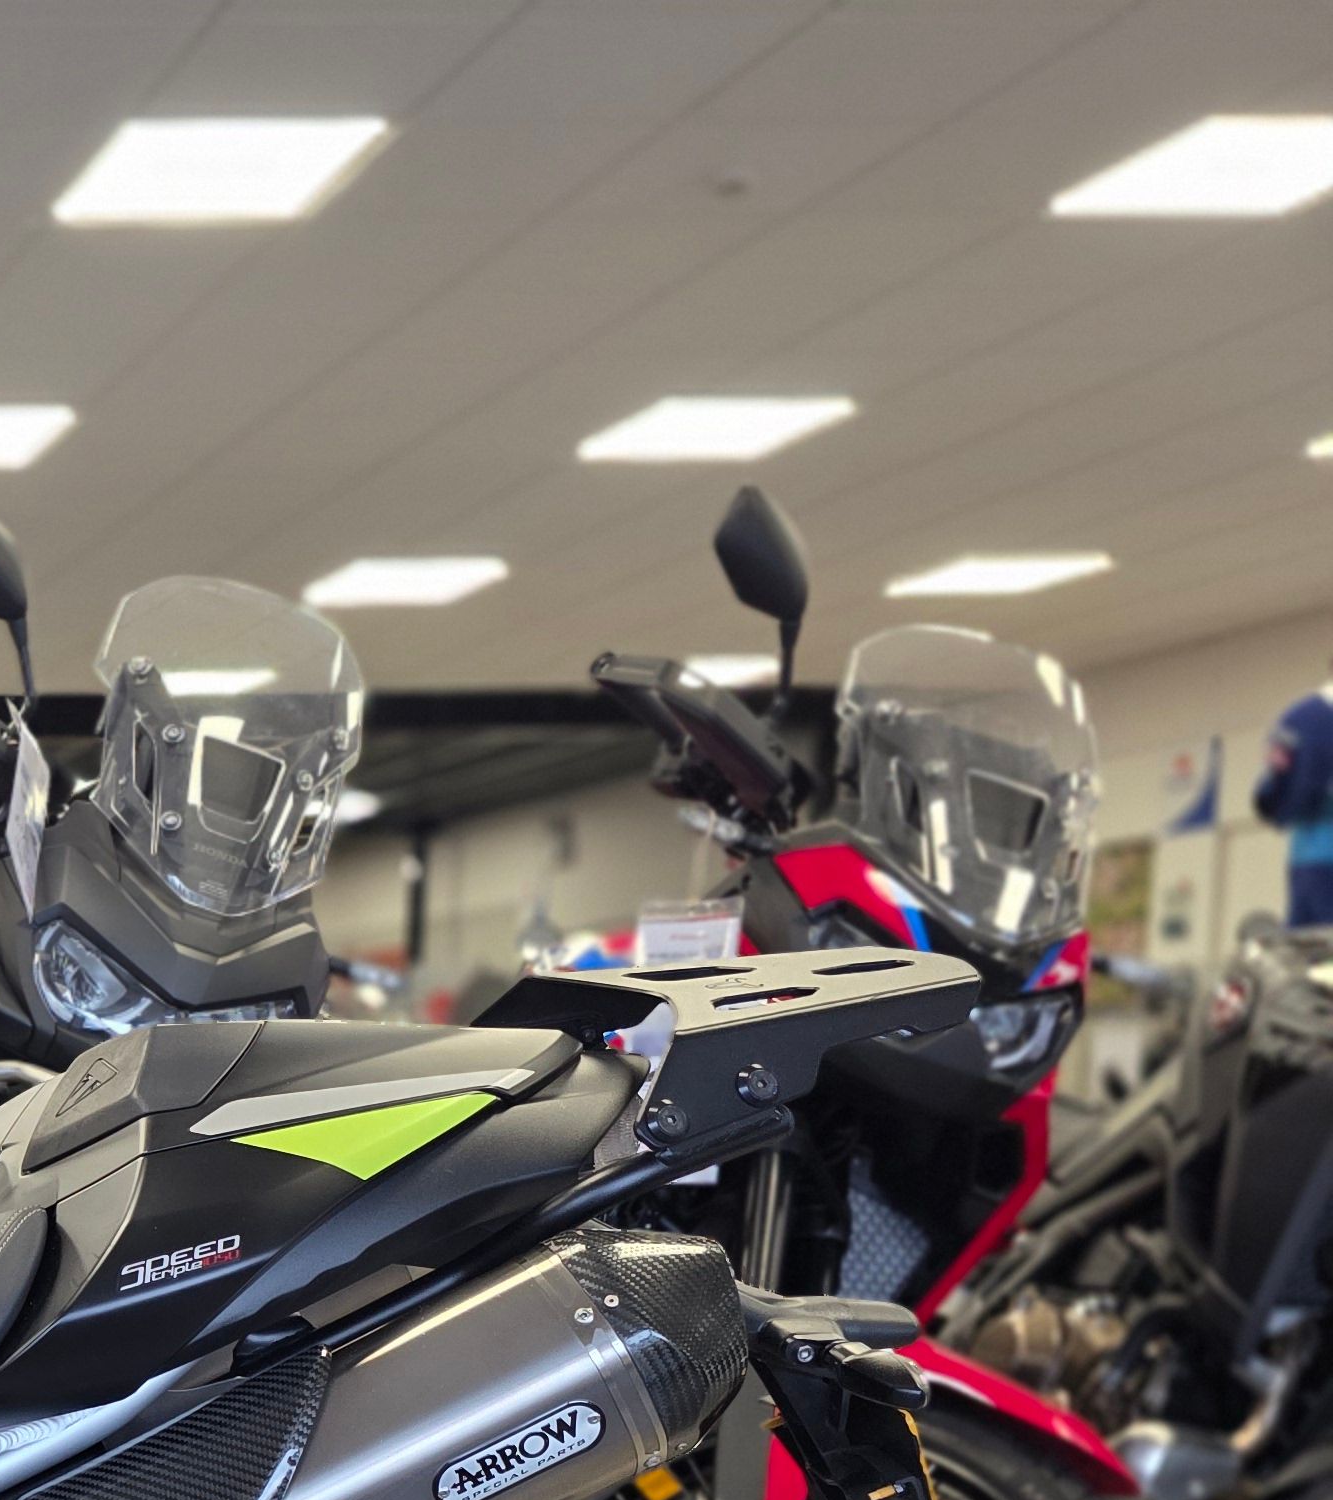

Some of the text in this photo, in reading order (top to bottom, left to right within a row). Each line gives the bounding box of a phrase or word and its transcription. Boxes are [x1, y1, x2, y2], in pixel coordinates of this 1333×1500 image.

[119, 1234, 241, 1292] SPEED
[151, 1260, 203, 1279] triple
[450, 1410, 579, 1496] ARROW
[536, 1438, 586, 1467] PARTS
